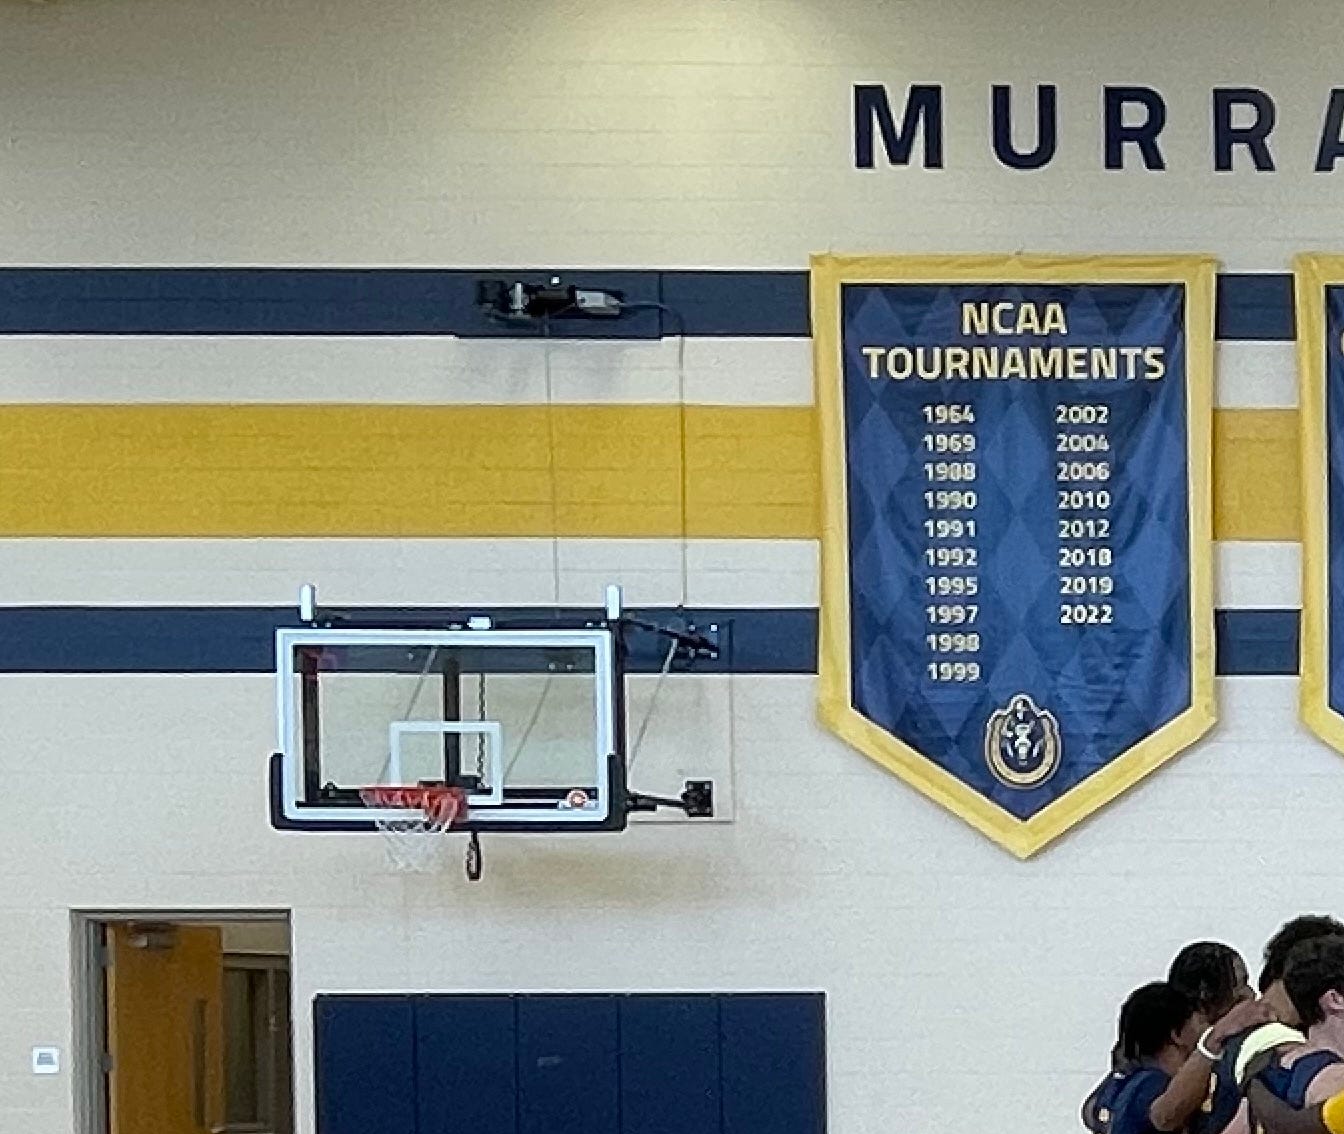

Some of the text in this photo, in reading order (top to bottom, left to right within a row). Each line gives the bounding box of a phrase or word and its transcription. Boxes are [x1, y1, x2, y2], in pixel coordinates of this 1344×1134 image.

[962, 302, 1068, 336] NCAA
[862, 346, 1164, 380] TOURNAMENTS
[922, 404, 975, 424] 1964
[1056, 404, 1108, 424] 2002
[924, 434, 976, 453] 1969
[1056, 434, 1110, 452] 2004
[924, 462, 976, 482] 1988
[1057, 462, 1110, 480] 2006
[924, 490, 977, 510] 1990
[1058, 490, 1110, 510] 2010
[924, 520, 976, 538] 1991
[1058, 518, 1110, 538] 2012
[926, 548, 978, 566] 1992
[1058, 548, 1112, 567] 2018
[926, 576, 978, 596] 1995
[1060, 576, 1114, 594] 2019
[926, 604, 978, 624] 1997
[1060, 604, 1112, 624] 2022
[926, 633, 980, 652] 1998
[928, 662, 980, 682] 1999
